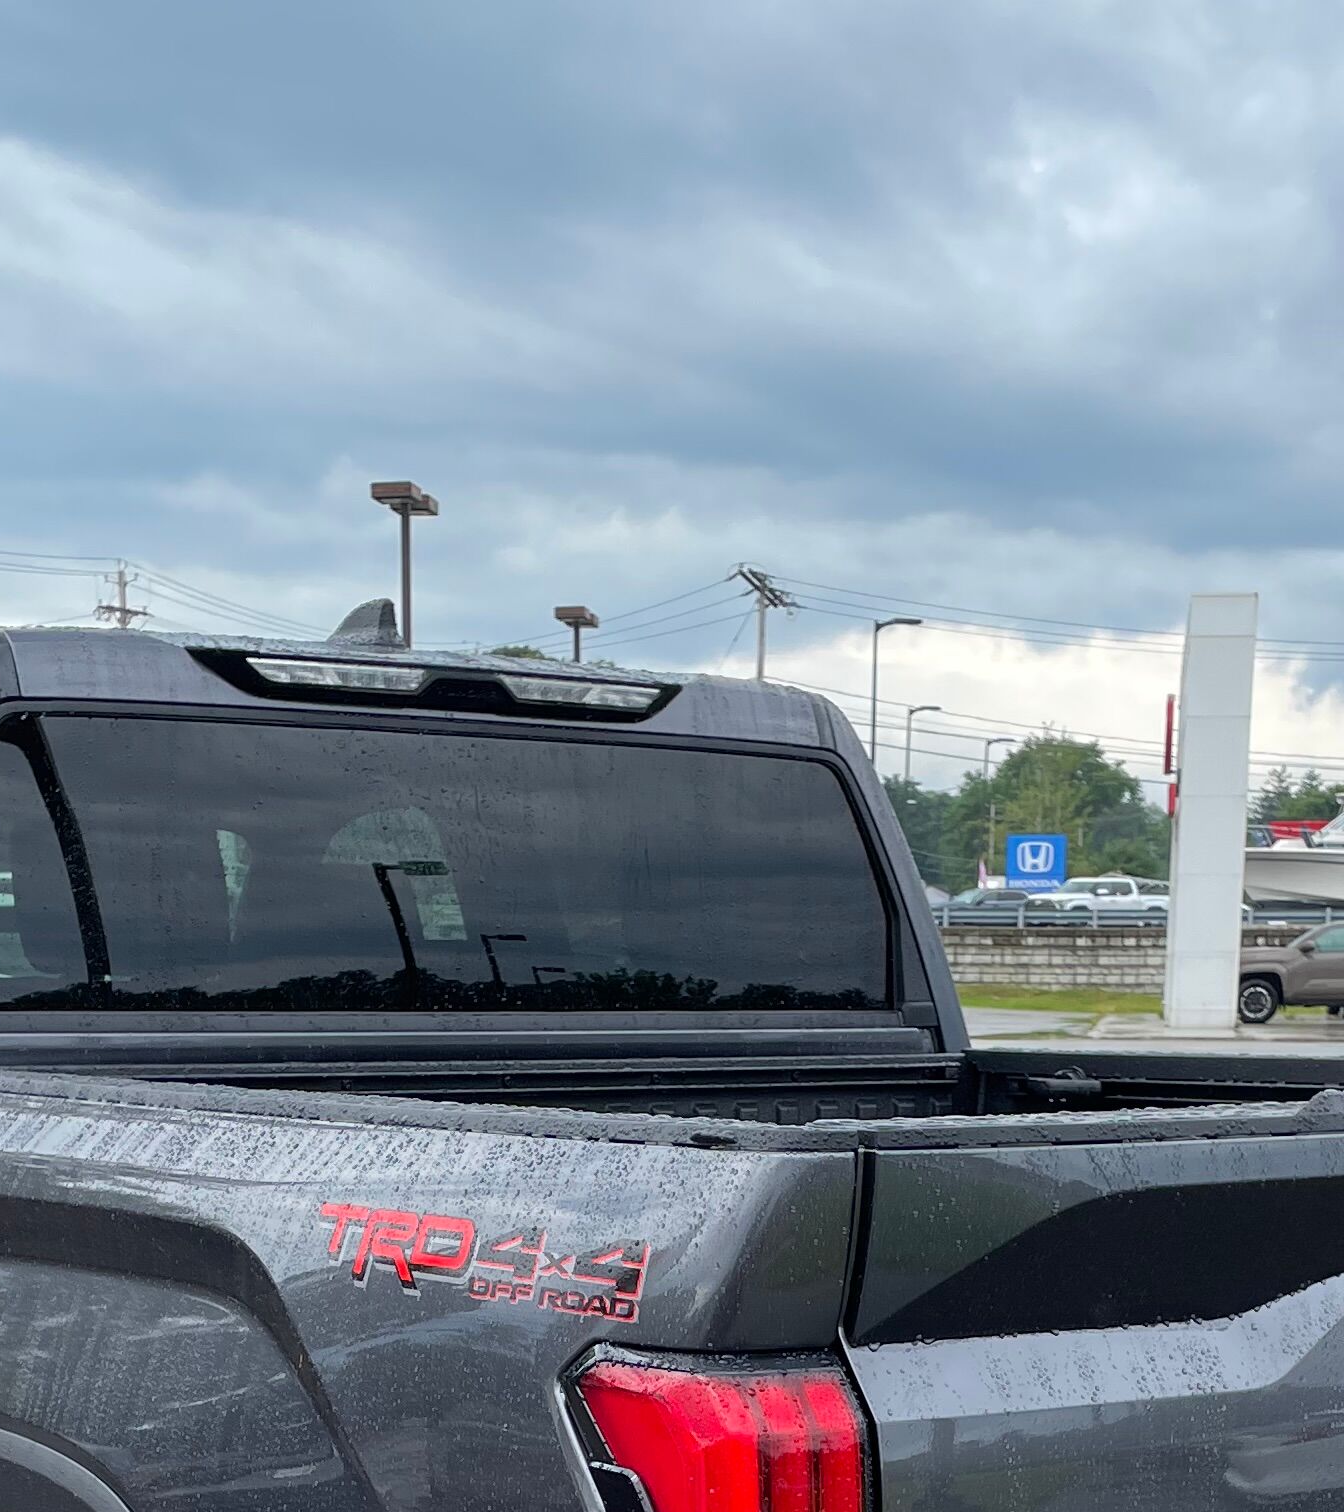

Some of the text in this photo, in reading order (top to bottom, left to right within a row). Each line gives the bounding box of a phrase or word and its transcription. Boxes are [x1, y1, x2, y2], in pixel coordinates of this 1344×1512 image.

[320, 1202, 478, 1291] TRD
[468, 1277, 640, 1323] OFF ROAD
